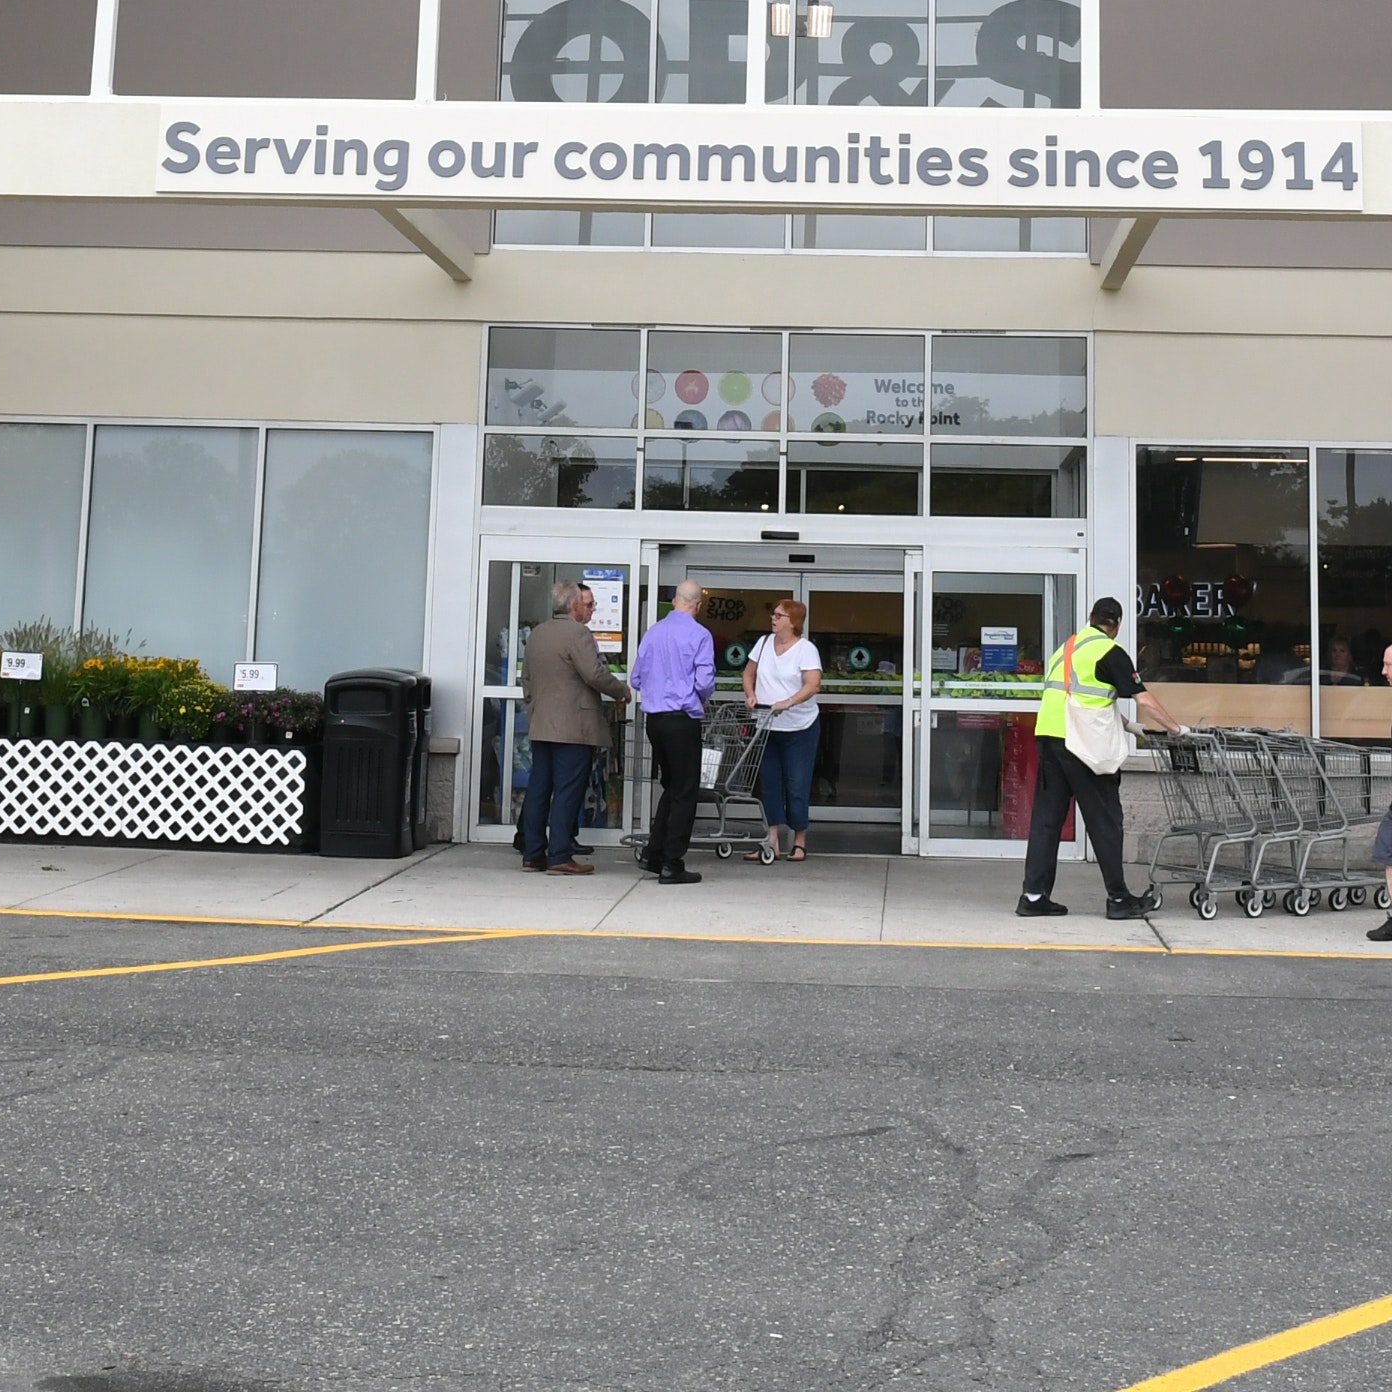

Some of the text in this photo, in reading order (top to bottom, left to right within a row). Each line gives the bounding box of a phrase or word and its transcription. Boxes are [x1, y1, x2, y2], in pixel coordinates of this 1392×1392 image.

[161, 121, 1359, 191] Serving our communities since 1914
[874, 379, 955, 395] Welcome
[895, 397, 908, 408] to
[866, 410, 914, 428] Rocky
